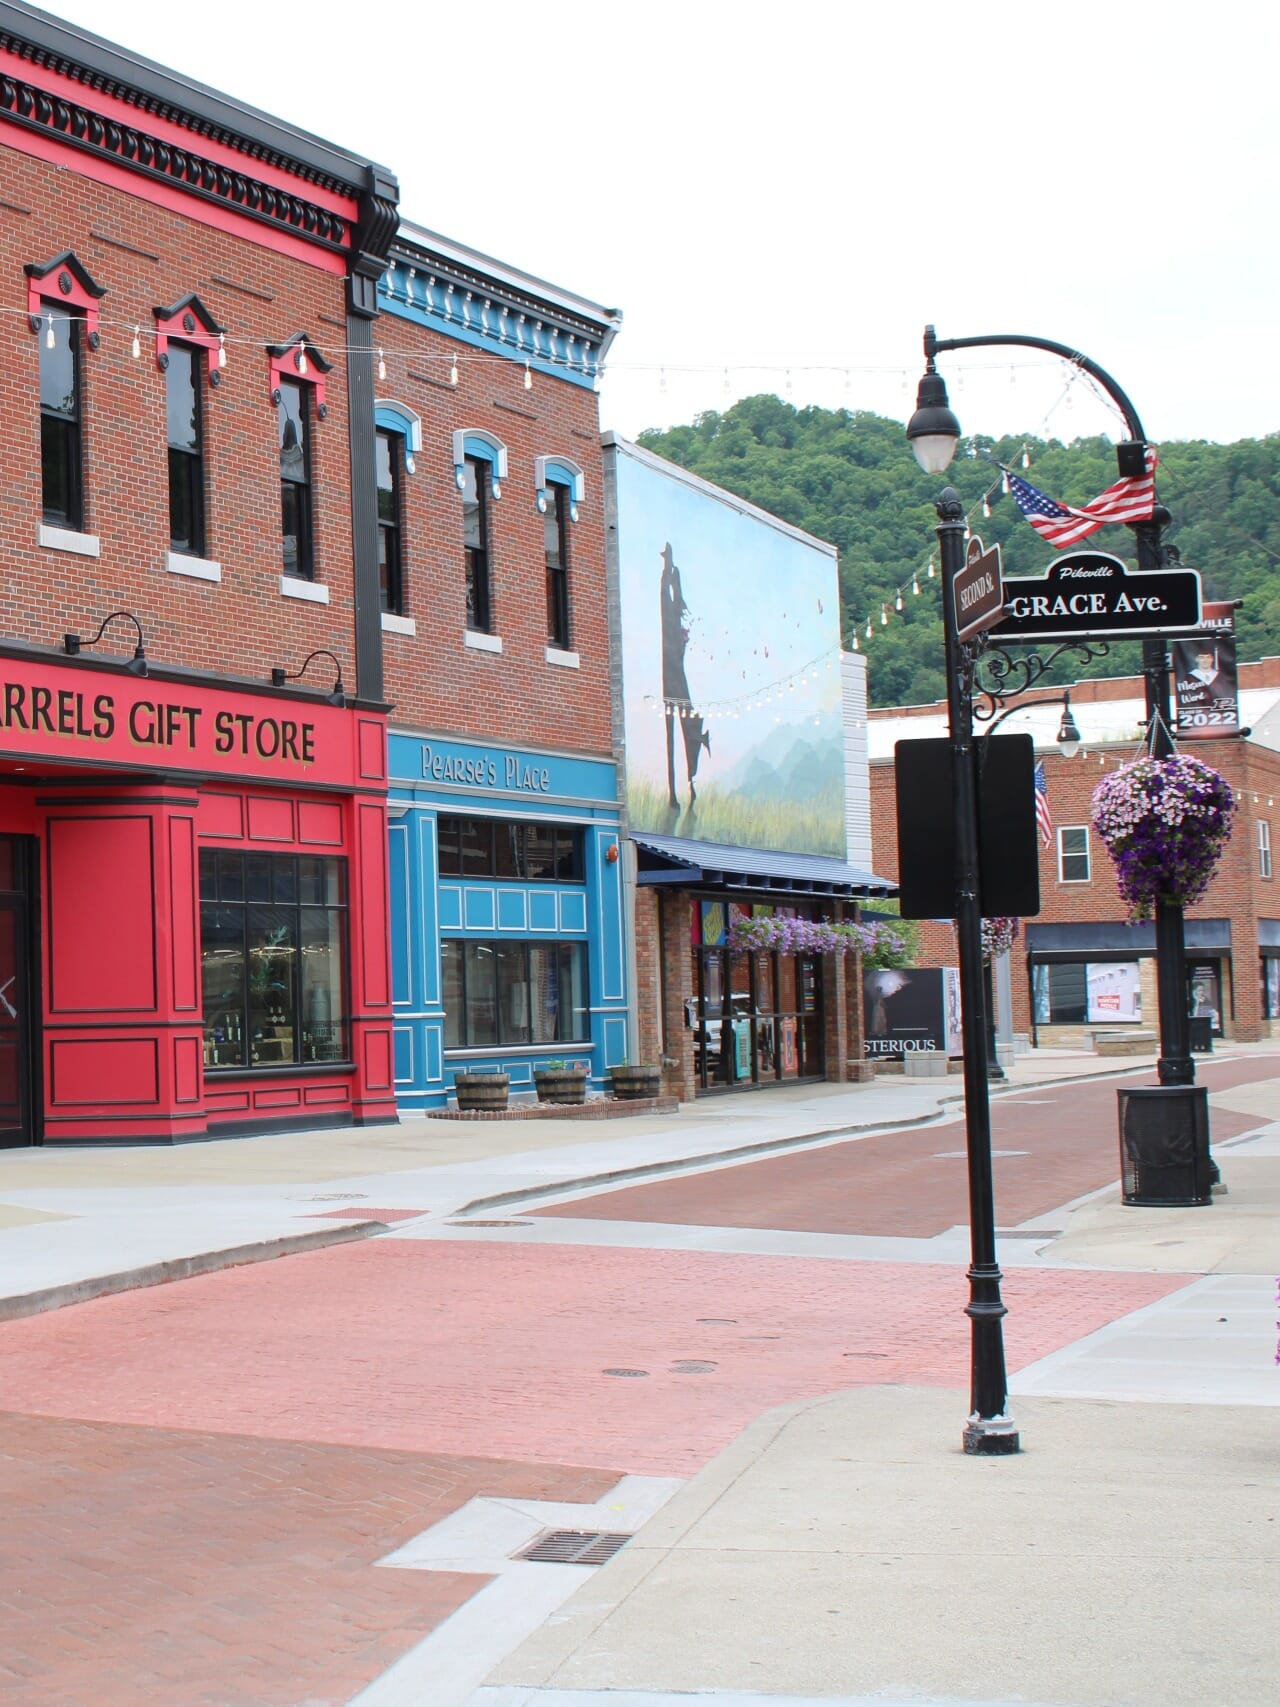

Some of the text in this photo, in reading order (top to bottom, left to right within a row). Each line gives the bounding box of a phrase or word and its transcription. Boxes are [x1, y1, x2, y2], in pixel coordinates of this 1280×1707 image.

[1059, 566, 1113, 580] Pikeville
[1012, 592, 1167, 617] GRACE Ave.
[1179, 712, 1237, 726] 2022
[129, 701, 203, 751] GIFT
[215, 711, 316, 765] STORE
[864, 1039, 936, 1052] STERIOUS
